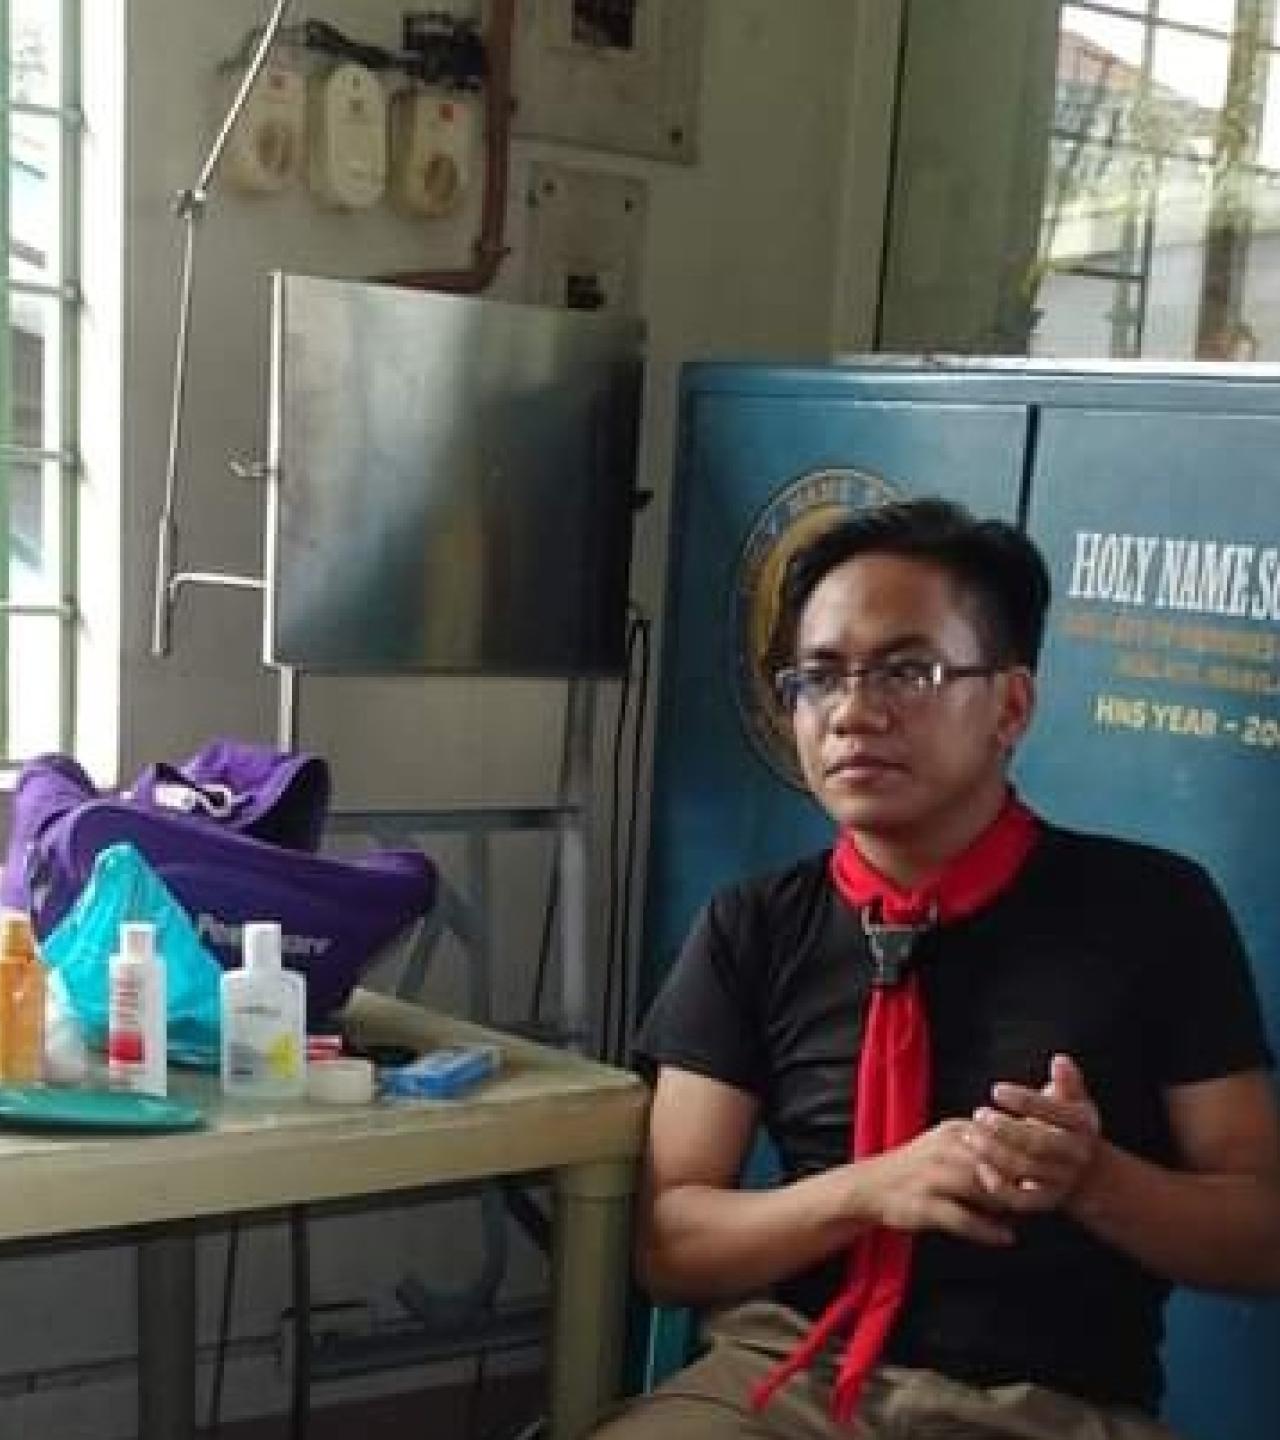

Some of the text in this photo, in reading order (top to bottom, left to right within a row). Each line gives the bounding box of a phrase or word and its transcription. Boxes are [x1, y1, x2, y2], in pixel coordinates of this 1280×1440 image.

[1068, 532, 1159, 605] HOLY
[1156, 540, 1253, 617] NAME
[1151, 704, 1218, 737] YEAR
